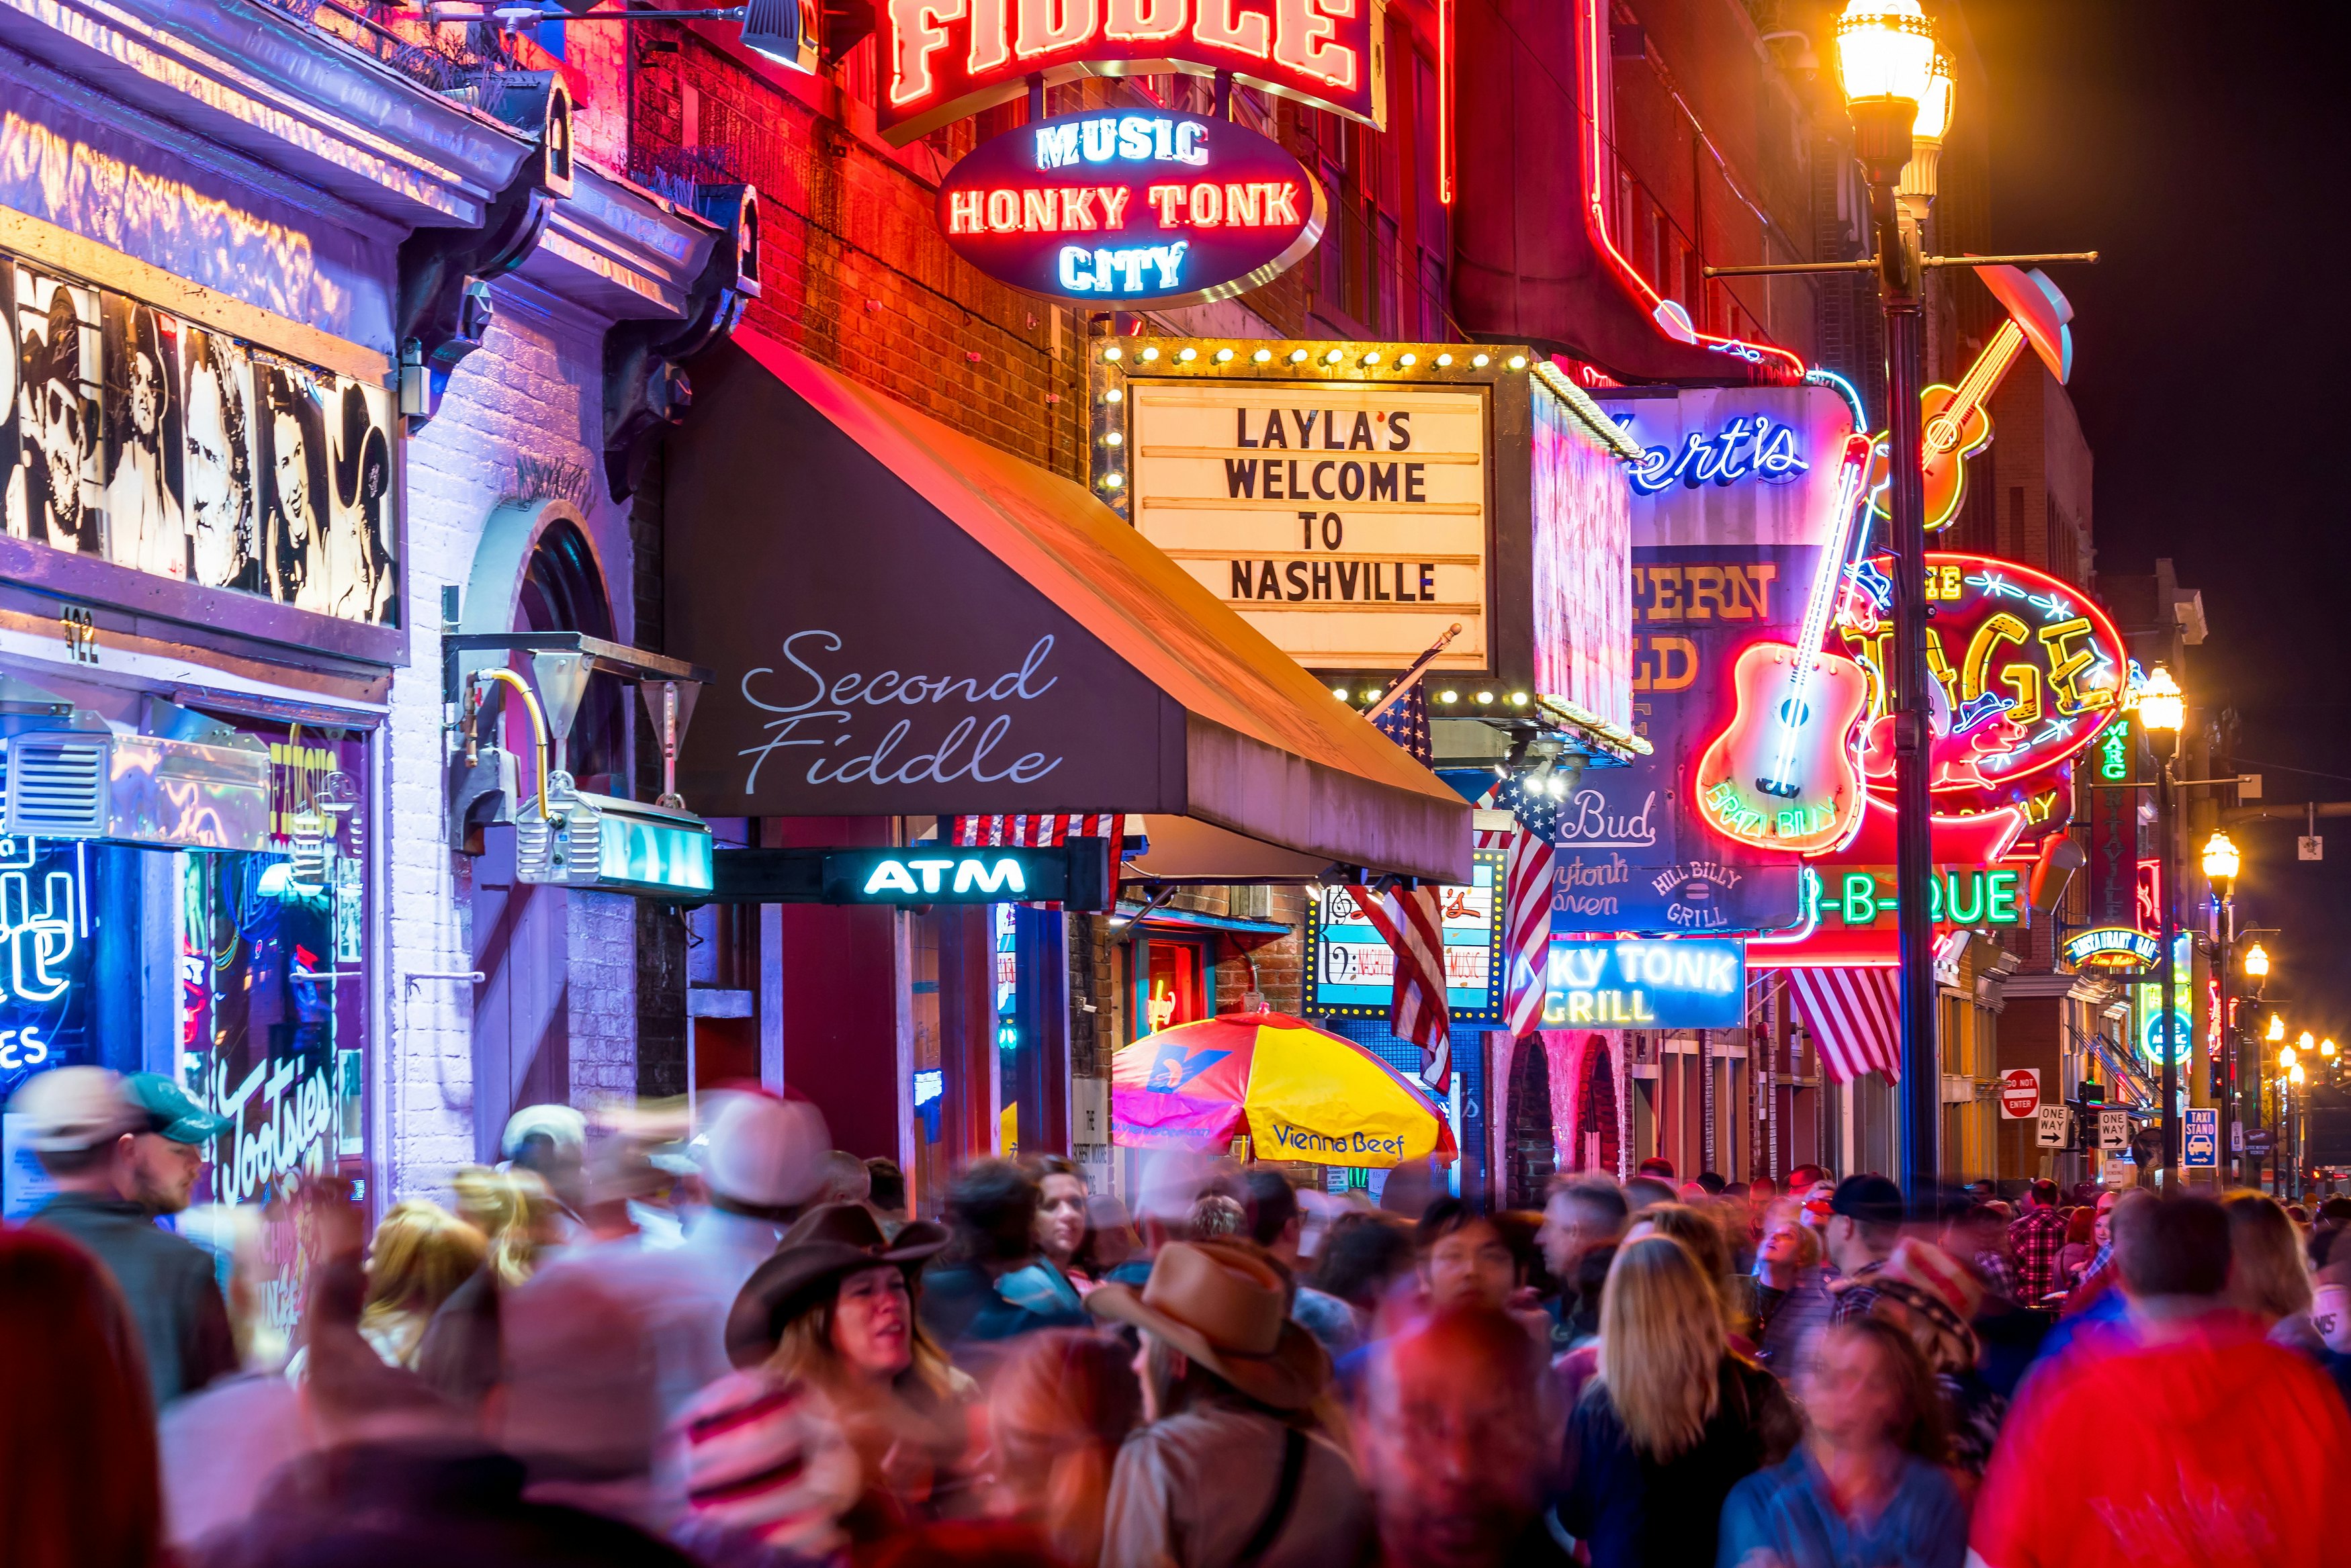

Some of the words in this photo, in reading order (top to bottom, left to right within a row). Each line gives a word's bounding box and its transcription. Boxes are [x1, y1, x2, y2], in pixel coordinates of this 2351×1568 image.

[1036, 116, 1209, 172] MUSIC
[948, 185, 1131, 234] HONKY
[1149, 181, 1302, 230] TONK
[1059, 240, 1190, 293] CITY
[1237, 407, 1411, 451] LAYLA'S
[1614, 412, 1810, 495] ert's
[1225, 459, 1426, 503] WELCOME
[1297, 512, 1342, 551] TO
[1231, 559, 1435, 602] NASHVILLE
[742, 630, 1059, 712] Second
[738, 710, 1063, 794] Fiddle
[1561, 789, 1656, 841] Bud
[863, 859, 1026, 894] ATM
[1652, 864, 1688, 897] HILL
[1688, 860, 1742, 890] BILLY
[1666, 903, 1728, 927] GRILL
[1449, 952, 1480, 978] MUSIC
[2135, 936, 2157, 958] BAR
[1616, 947, 1738, 993] TONK
[1543, 990, 1655, 1023] GRILL
[2009, 1101, 2031, 1109] ENTER
[2042, 1109, 2064, 1119] ONE
[2103, 1115, 2124, 1123] ONE
[2191, 1112, 2211, 1123] TAXI
[216, 1052, 332, 1209] Tootsies
[1273, 1124, 1347, 1153] Vienna
[1353, 1132, 1405, 1161] Beef
[2041, 1120, 2064, 1131] WAY
[2102, 1125, 2125, 1134] WAY
[2186, 1123, 2215, 1135] STAND
